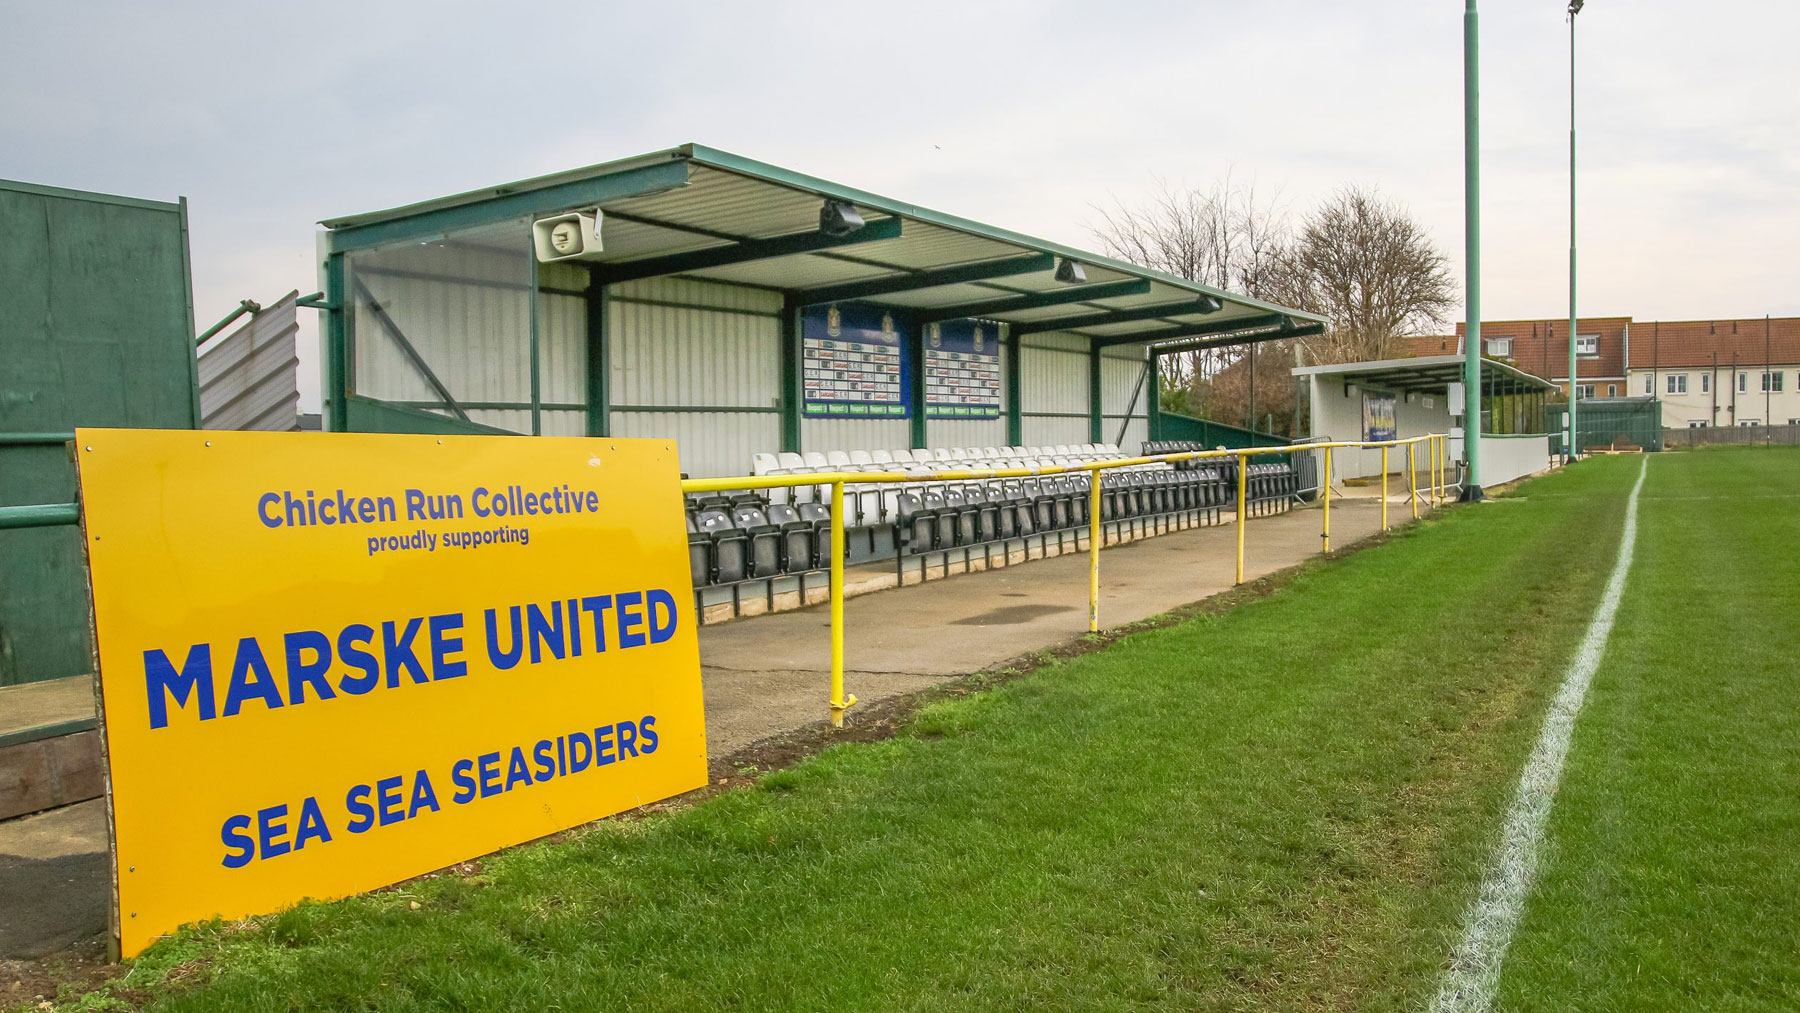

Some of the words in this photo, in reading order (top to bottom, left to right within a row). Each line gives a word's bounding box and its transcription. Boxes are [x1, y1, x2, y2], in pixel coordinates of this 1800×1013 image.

[258, 489, 397, 527] Chicken
[405, 488, 463, 521] Run
[472, 485, 600, 518] Collective
[367, 530, 437, 556] proudly
[442, 526, 530, 549] supporting
[143, 612, 468, 730] MARSKE
[484, 588, 679, 671] UNITED
[221, 796, 332, 869] SEA
[346, 769, 440, 834] SEA
[452, 715, 659, 804] SEASIDERS
